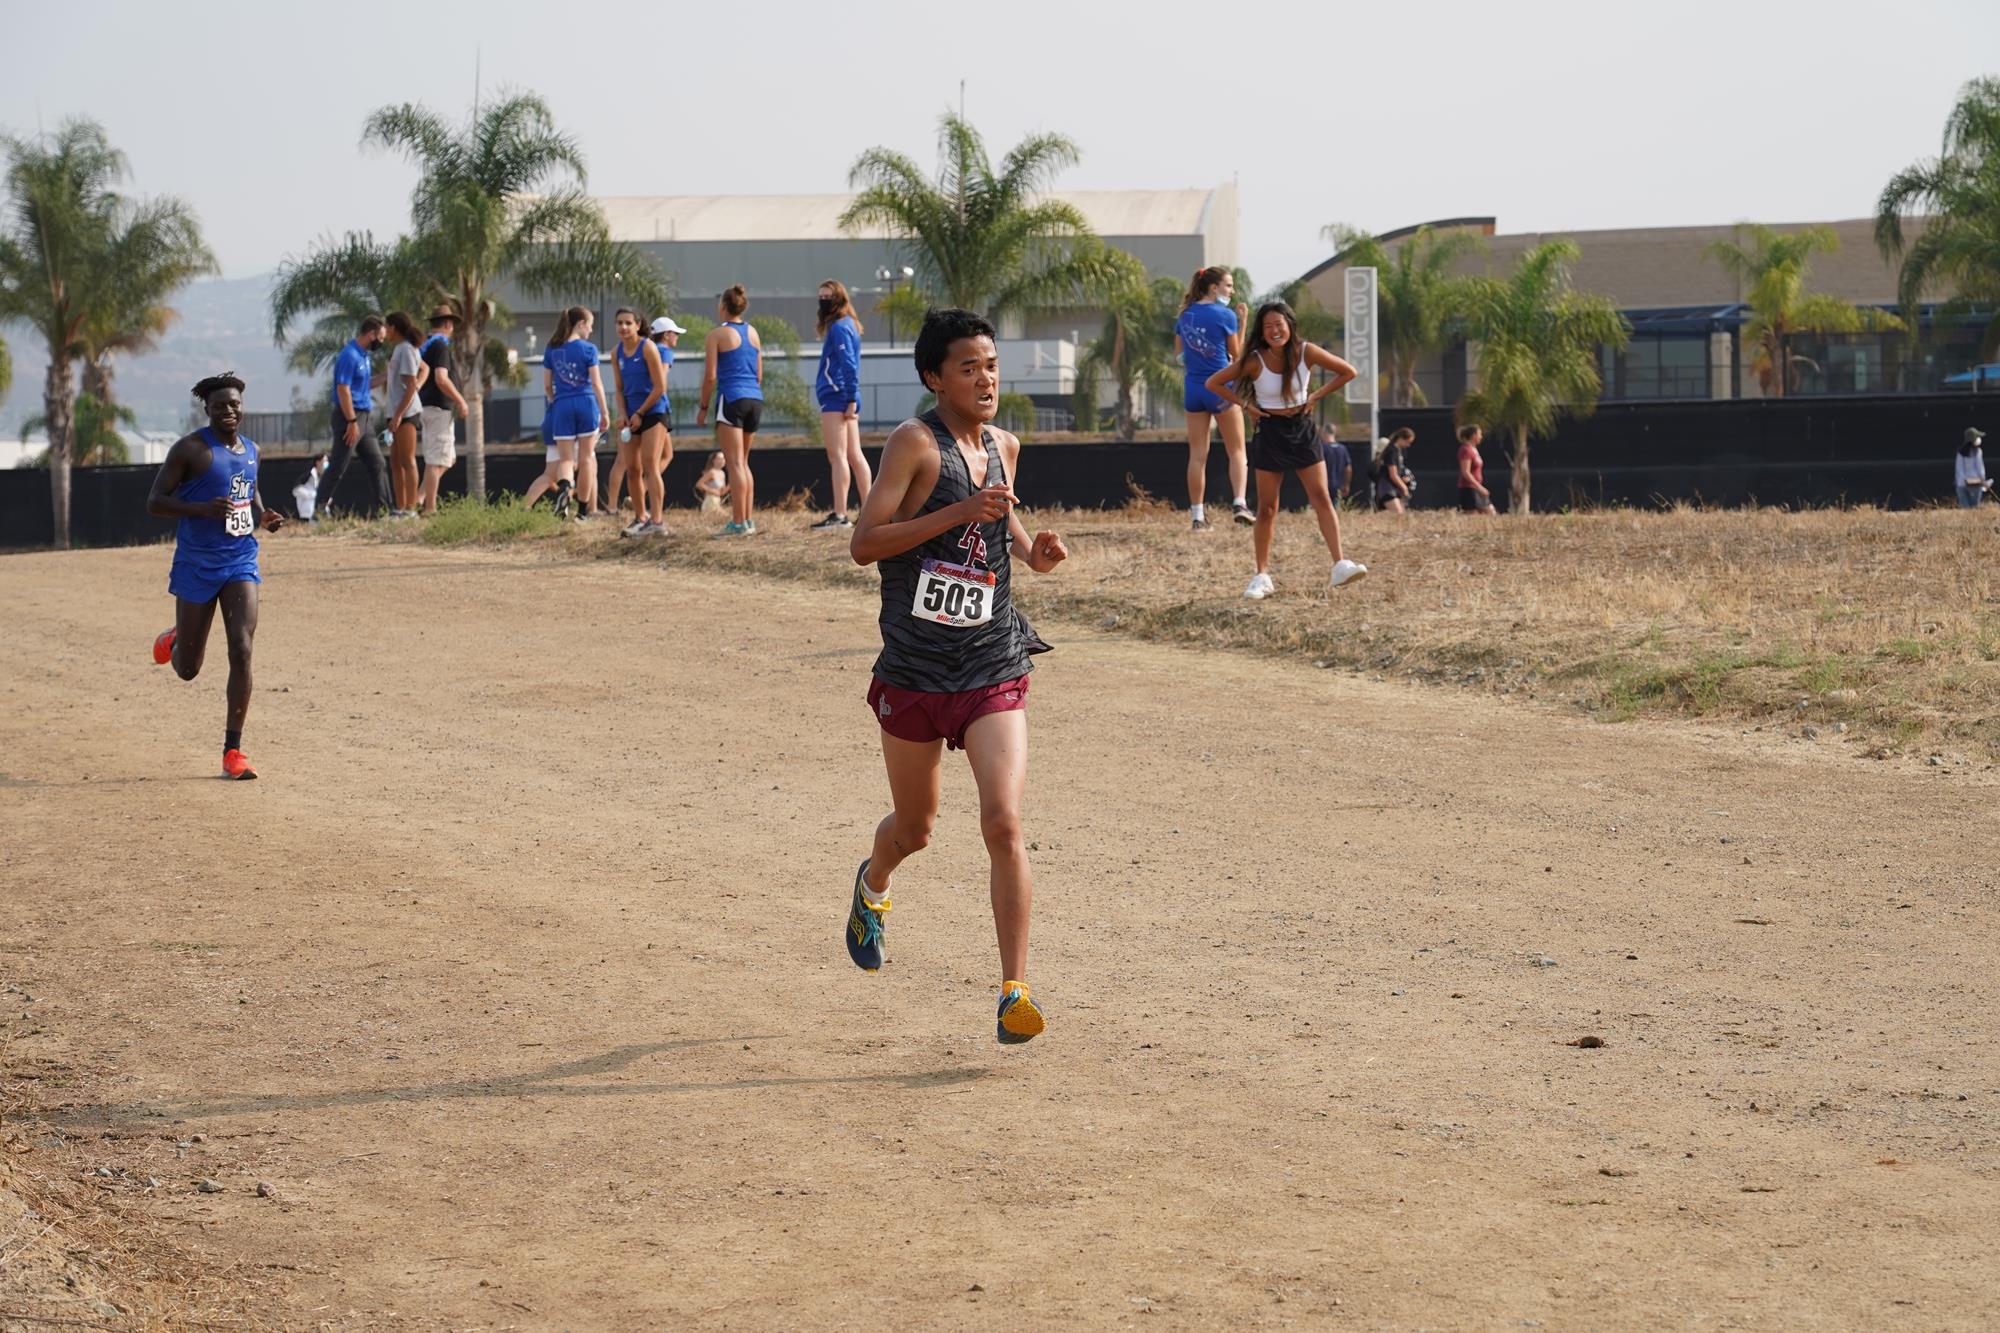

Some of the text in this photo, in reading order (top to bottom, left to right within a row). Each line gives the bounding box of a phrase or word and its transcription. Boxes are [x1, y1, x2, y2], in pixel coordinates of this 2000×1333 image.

[229, 470, 254, 500] SM
[923, 578, 984, 620] 503
[936, 614, 966, 625] MileSplit
